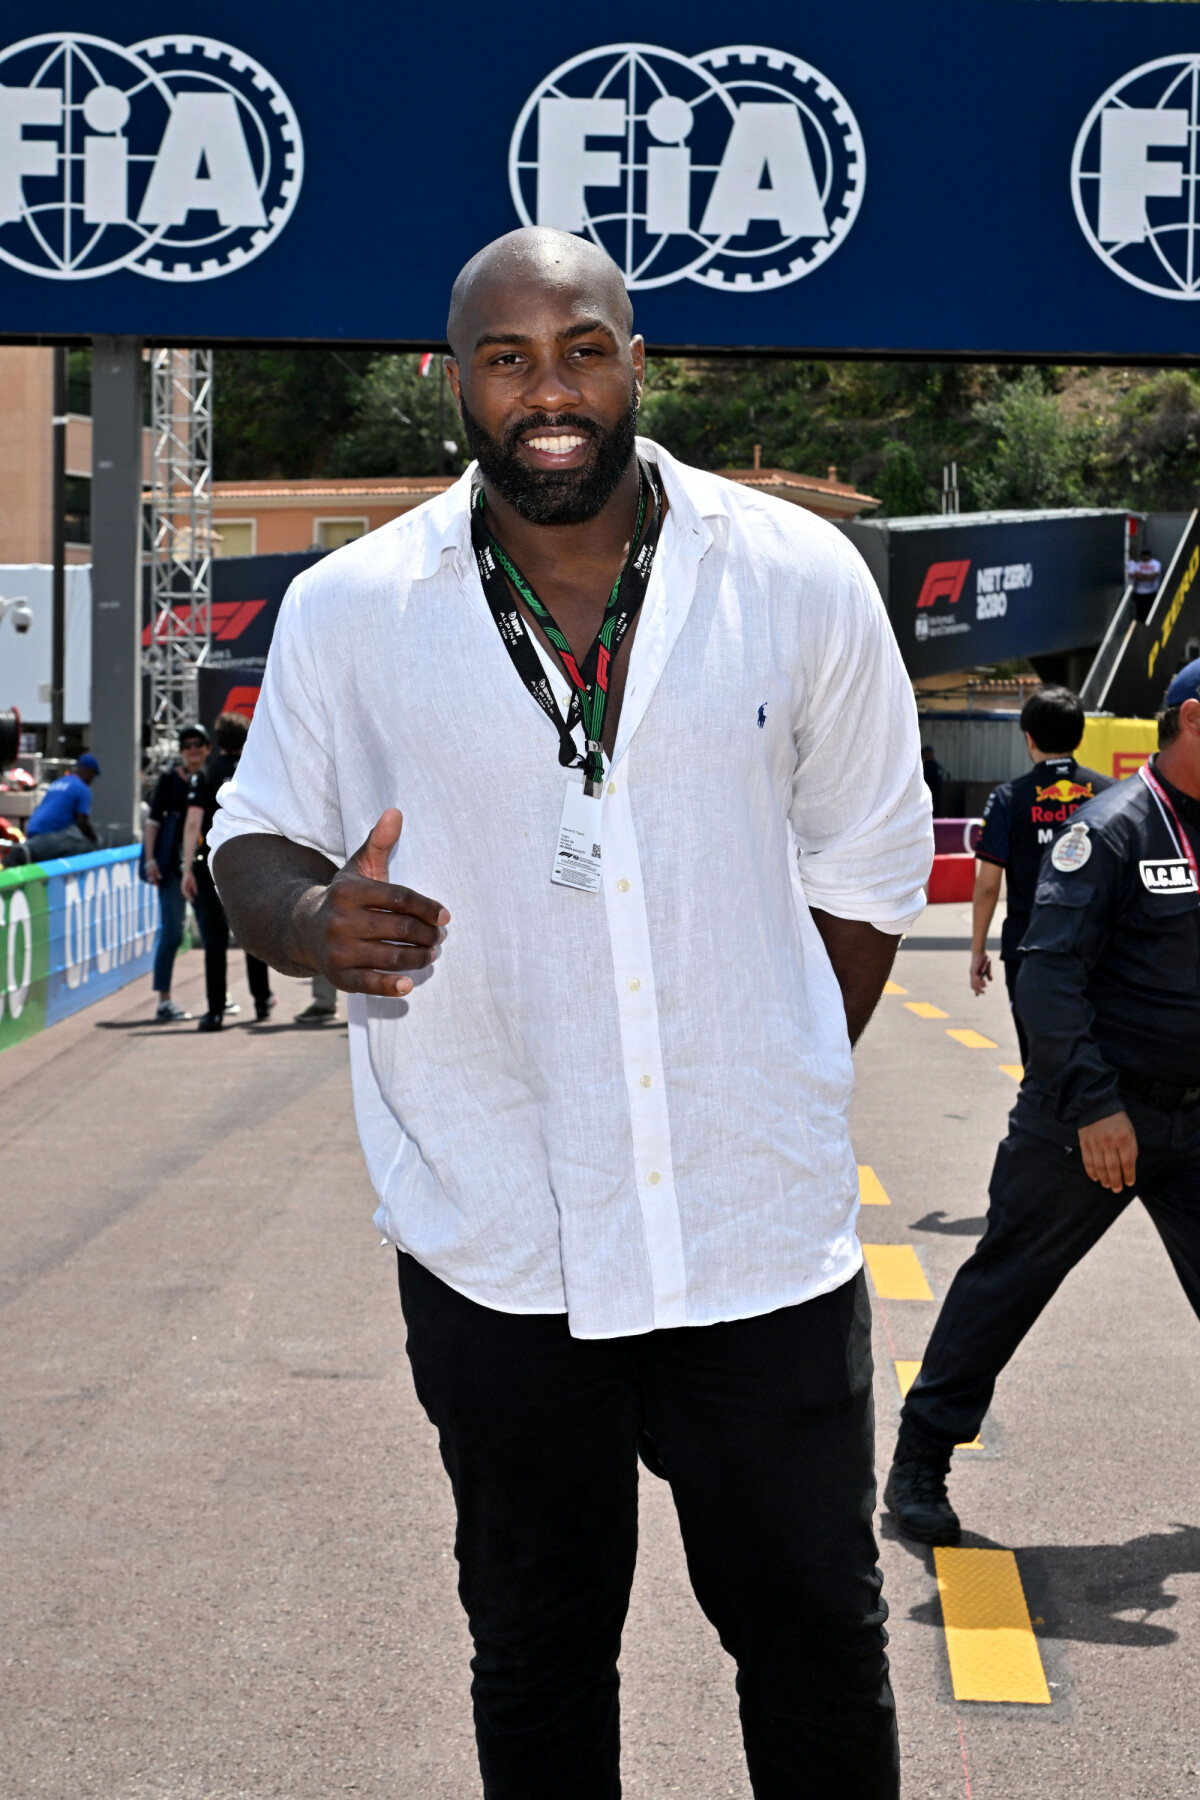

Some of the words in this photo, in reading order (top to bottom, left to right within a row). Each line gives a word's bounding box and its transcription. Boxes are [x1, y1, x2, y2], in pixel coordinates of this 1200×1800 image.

[486, 553, 496, 571] BWT
[638, 544, 648, 563] BWT
[640, 544, 654, 577] ALPINE
[478, 550, 491, 580] ALPINE
[498, 610, 518, 646] ALPINE
[511, 618, 524, 637] BWT
[1031, 804, 1068, 823] Red
